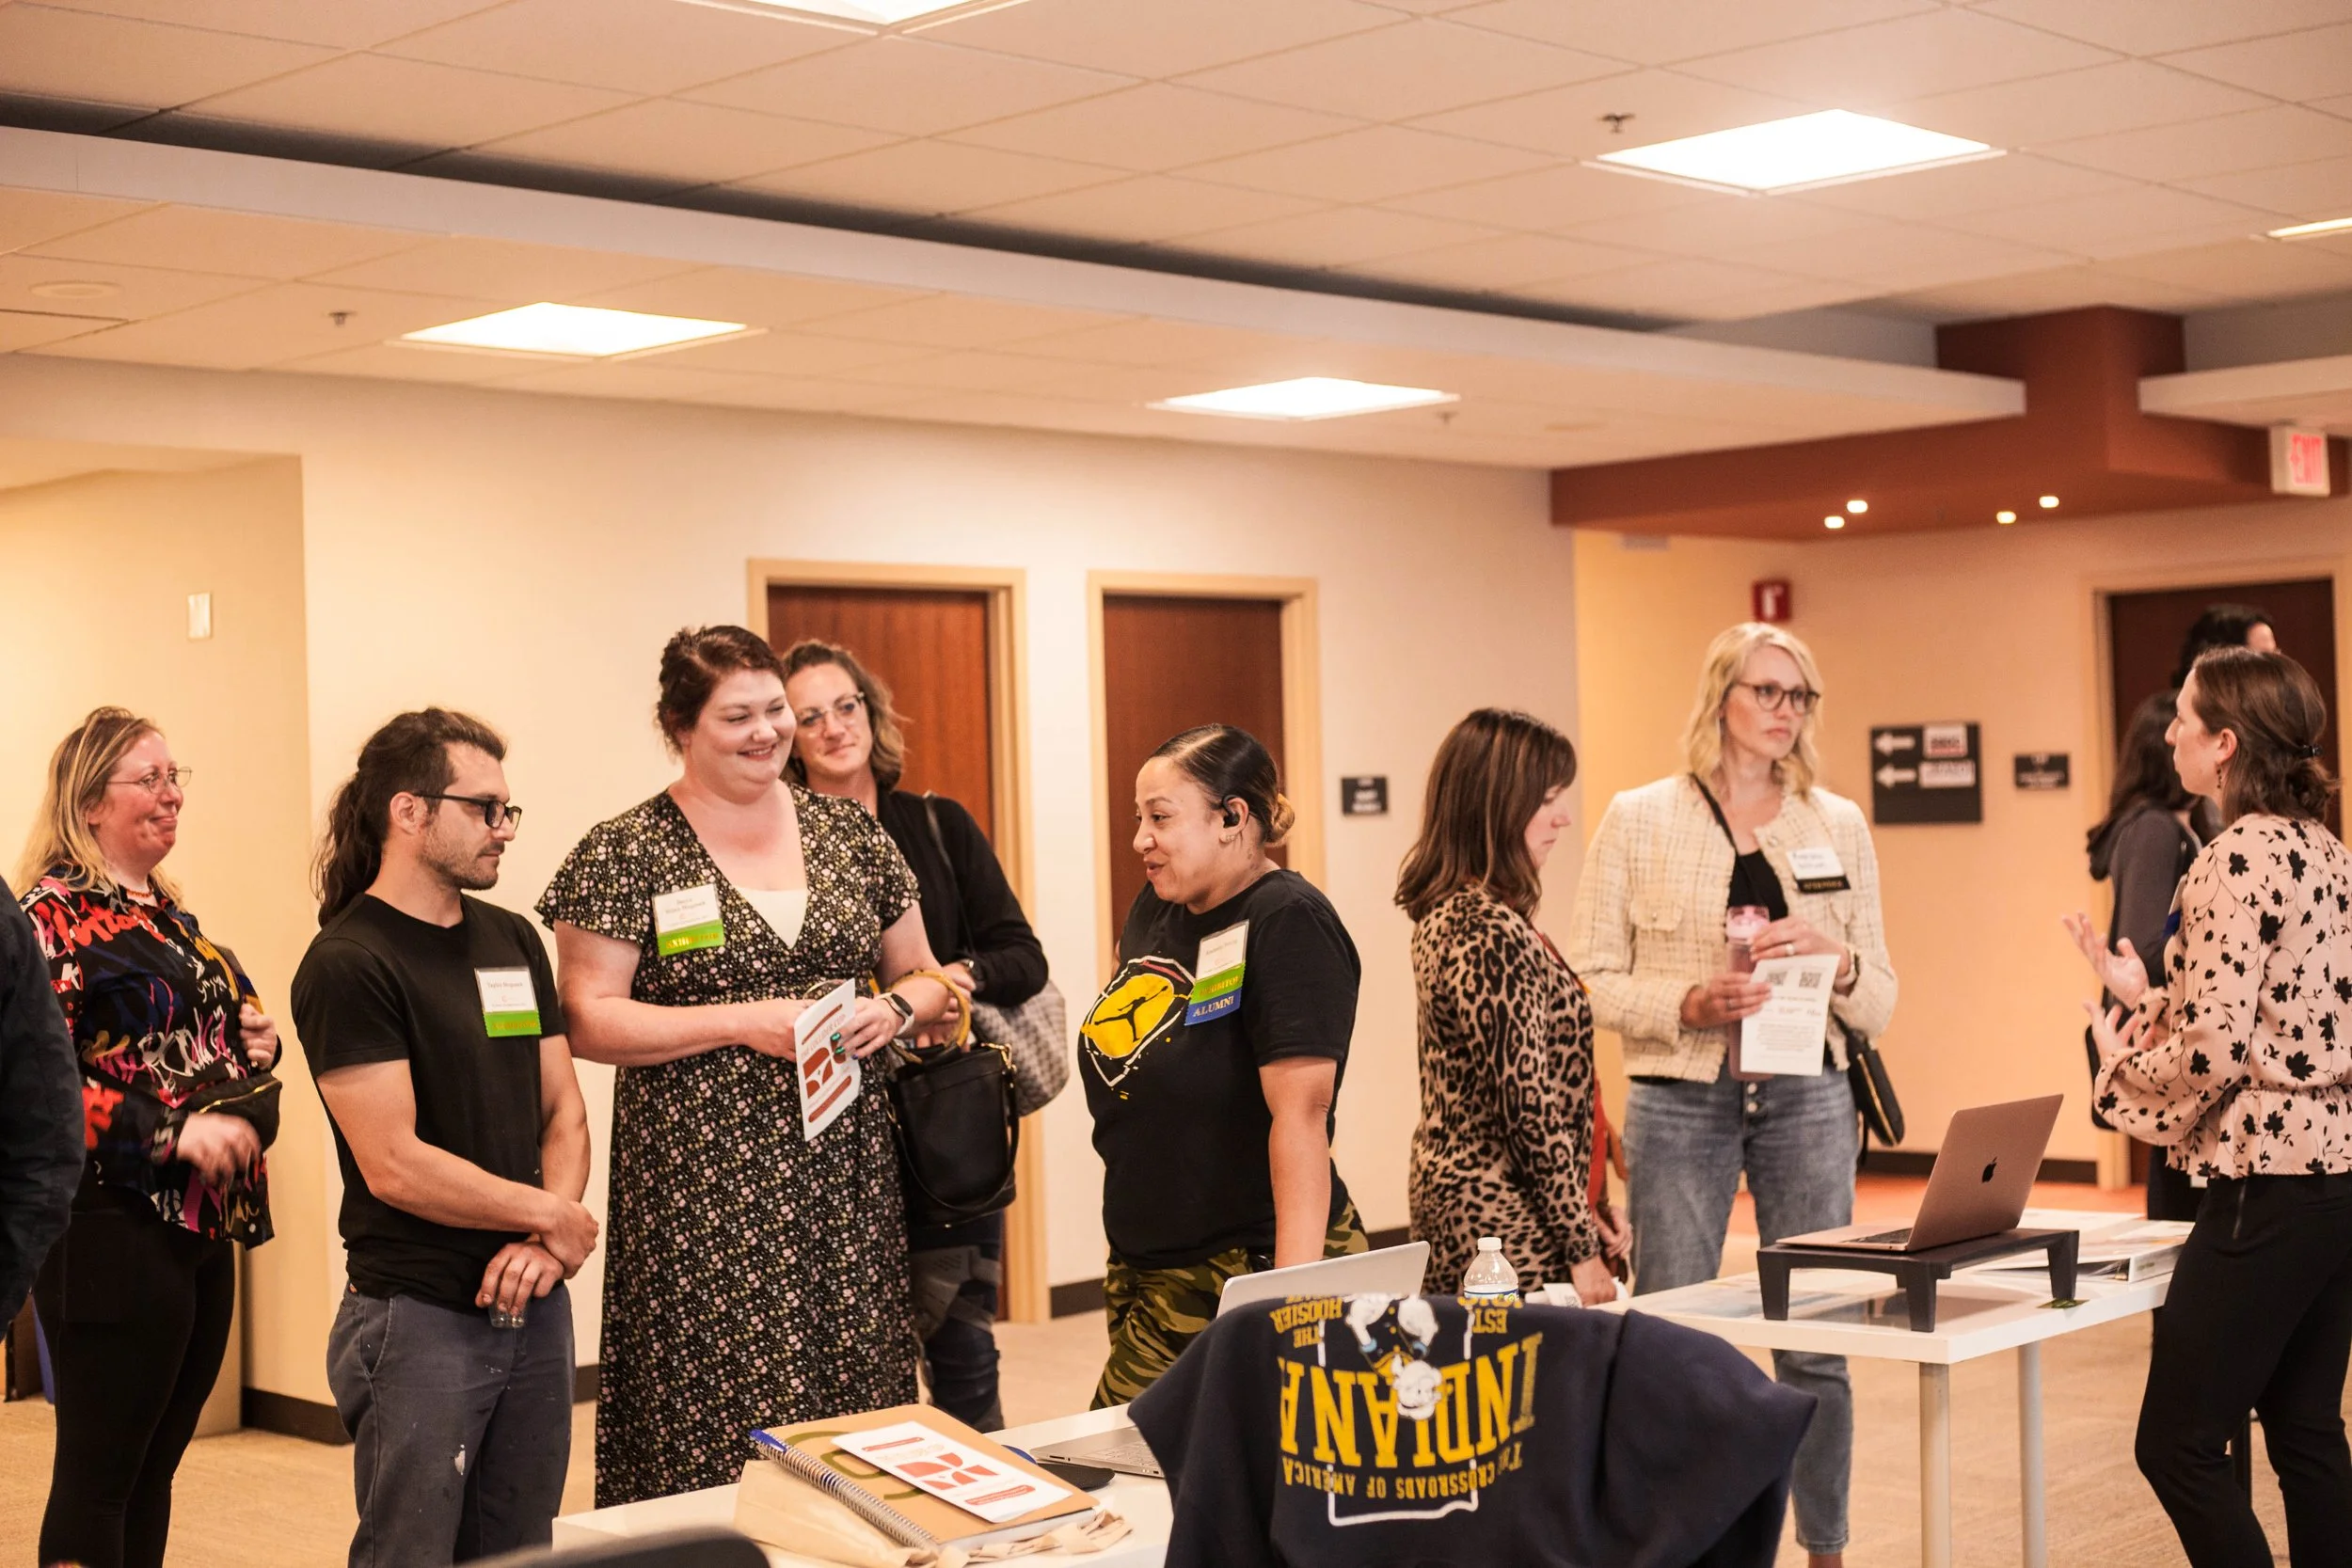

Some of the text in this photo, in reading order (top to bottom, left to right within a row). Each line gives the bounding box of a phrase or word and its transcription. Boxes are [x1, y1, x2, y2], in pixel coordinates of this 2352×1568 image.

[1193, 995, 1234, 1017] ALUMNI
[1269, 1298, 1343, 1334] HOOSIER
[1471, 1308, 1508, 1334] EST
[1294, 1325, 1323, 1348] THE
[1282, 1457, 1357, 1497] AMERICA
[1366, 1477, 1387, 1498] OF
[1395, 1460, 1495, 1499] CROSSROADS
